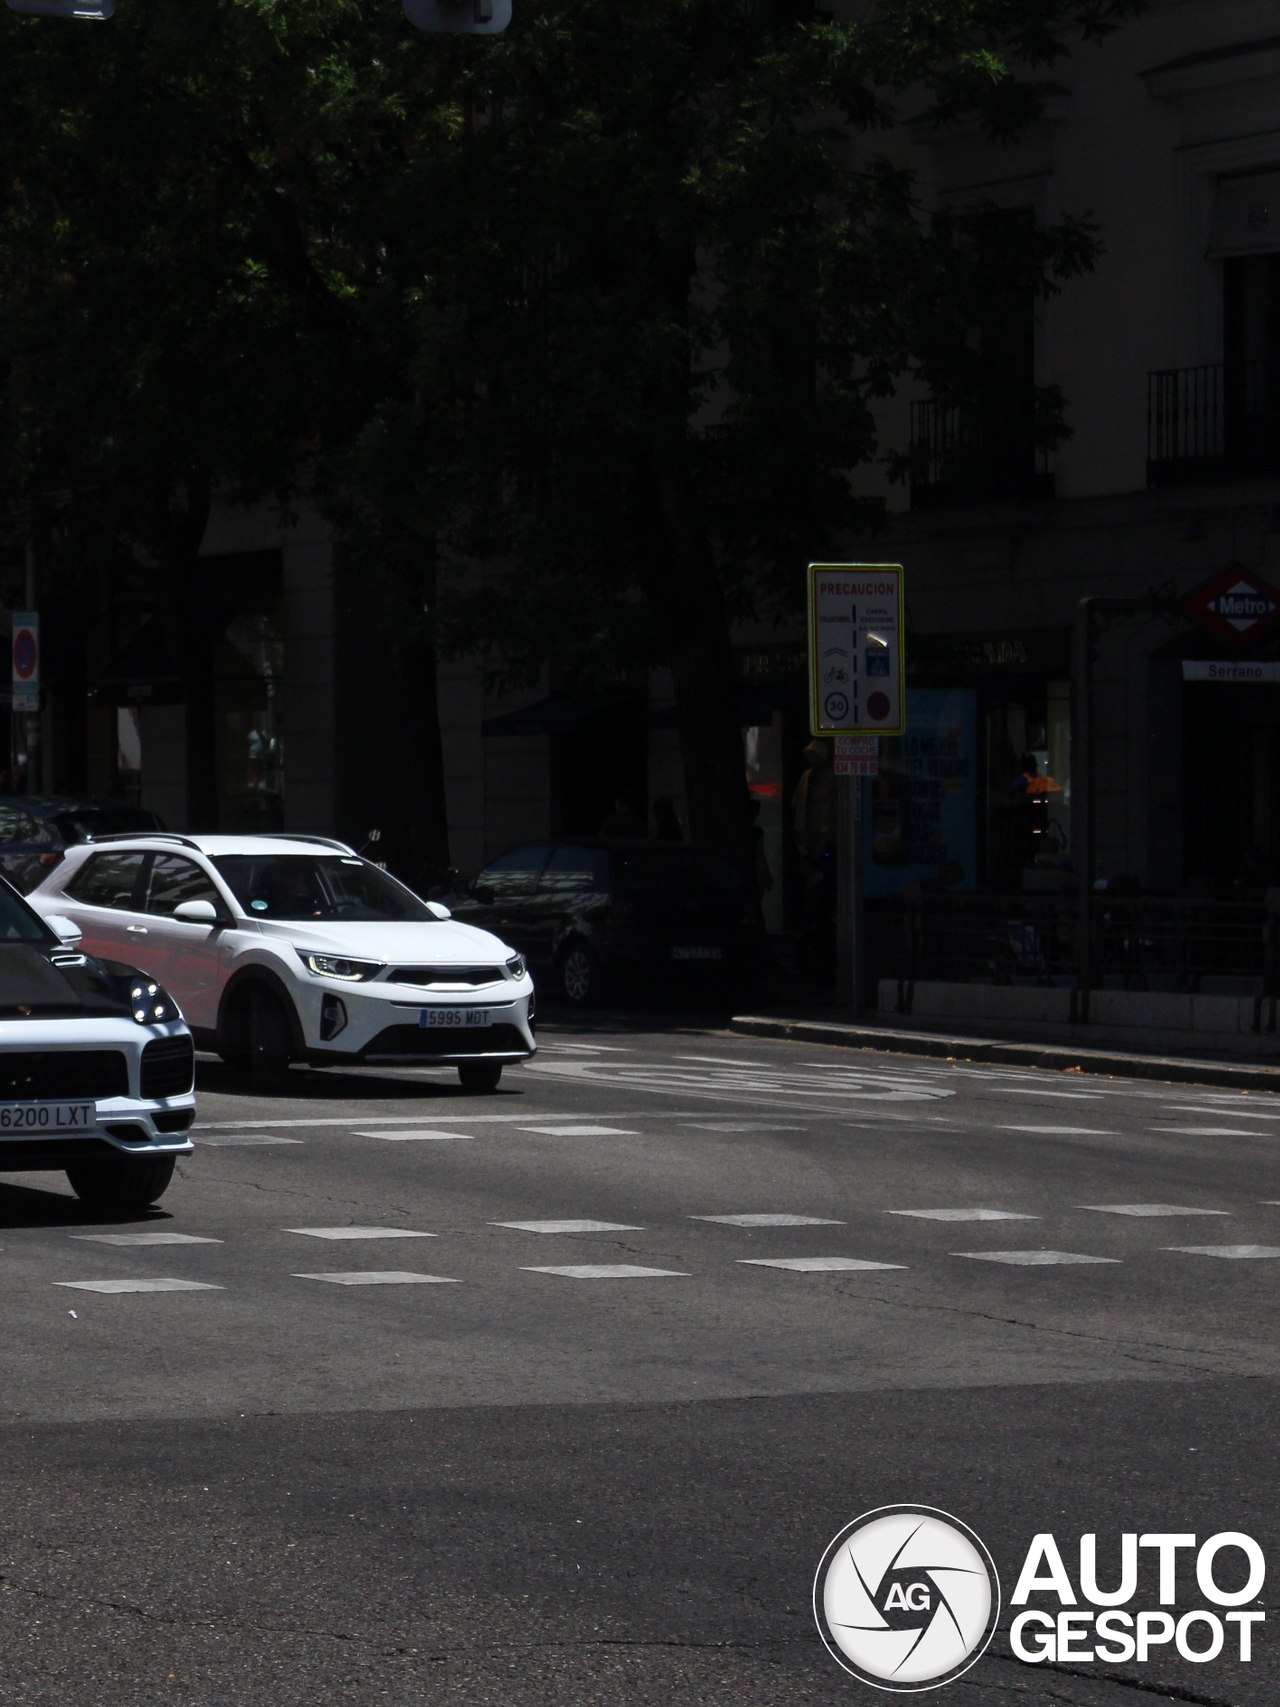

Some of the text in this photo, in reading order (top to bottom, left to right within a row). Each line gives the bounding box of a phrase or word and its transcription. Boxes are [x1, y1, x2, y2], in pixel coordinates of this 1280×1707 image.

[820, 580, 894, 595] PRECAUCIÓN
[1220, 596, 1266, 614] Metro
[1208, 664, 1262, 678] Serrano
[830, 701, 844, 712] 30
[838, 737, 875, 746] COMPRO
[836, 746, 877, 755] TU COCHE
[429, 1010, 490, 1025] 5995 MDT
[0, 1107, 49, 1127] 6200
[56, 1105, 90, 1126] LXT
